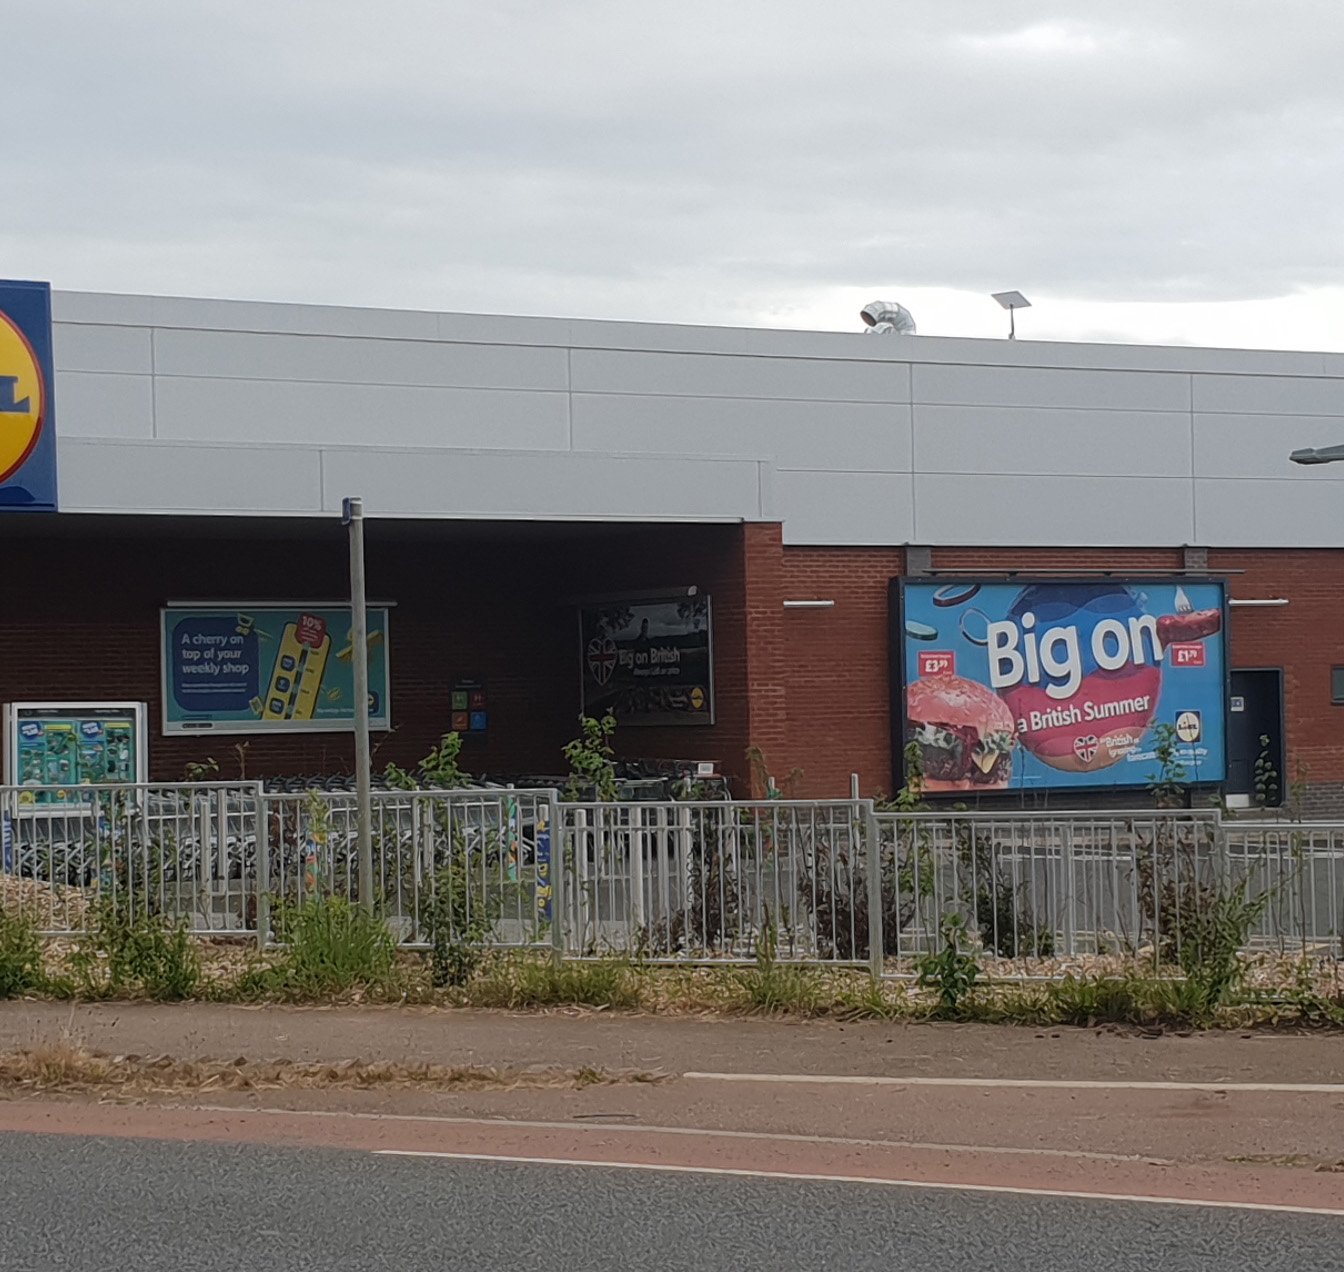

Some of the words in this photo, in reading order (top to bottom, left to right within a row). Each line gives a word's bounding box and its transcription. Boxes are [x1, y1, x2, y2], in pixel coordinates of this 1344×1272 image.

[181, 633, 190, 644] A
[192, 634, 227, 646] cherry
[229, 636, 244, 644] on
[182, 649, 201, 660] top
[204, 648, 215, 658] of
[217, 651, 242, 660] your
[635, 652, 648, 664] on
[650, 646, 681, 664] British
[987, 612, 1082, 699] Big
[1091, 614, 1164, 671] on
[182, 662, 220, 675] weekly
[223, 662, 250, 675] shop
[1017, 718, 1028, 733] a
[1030, 704, 1082, 731] British
[1083, 694, 1150, 721] Summer
